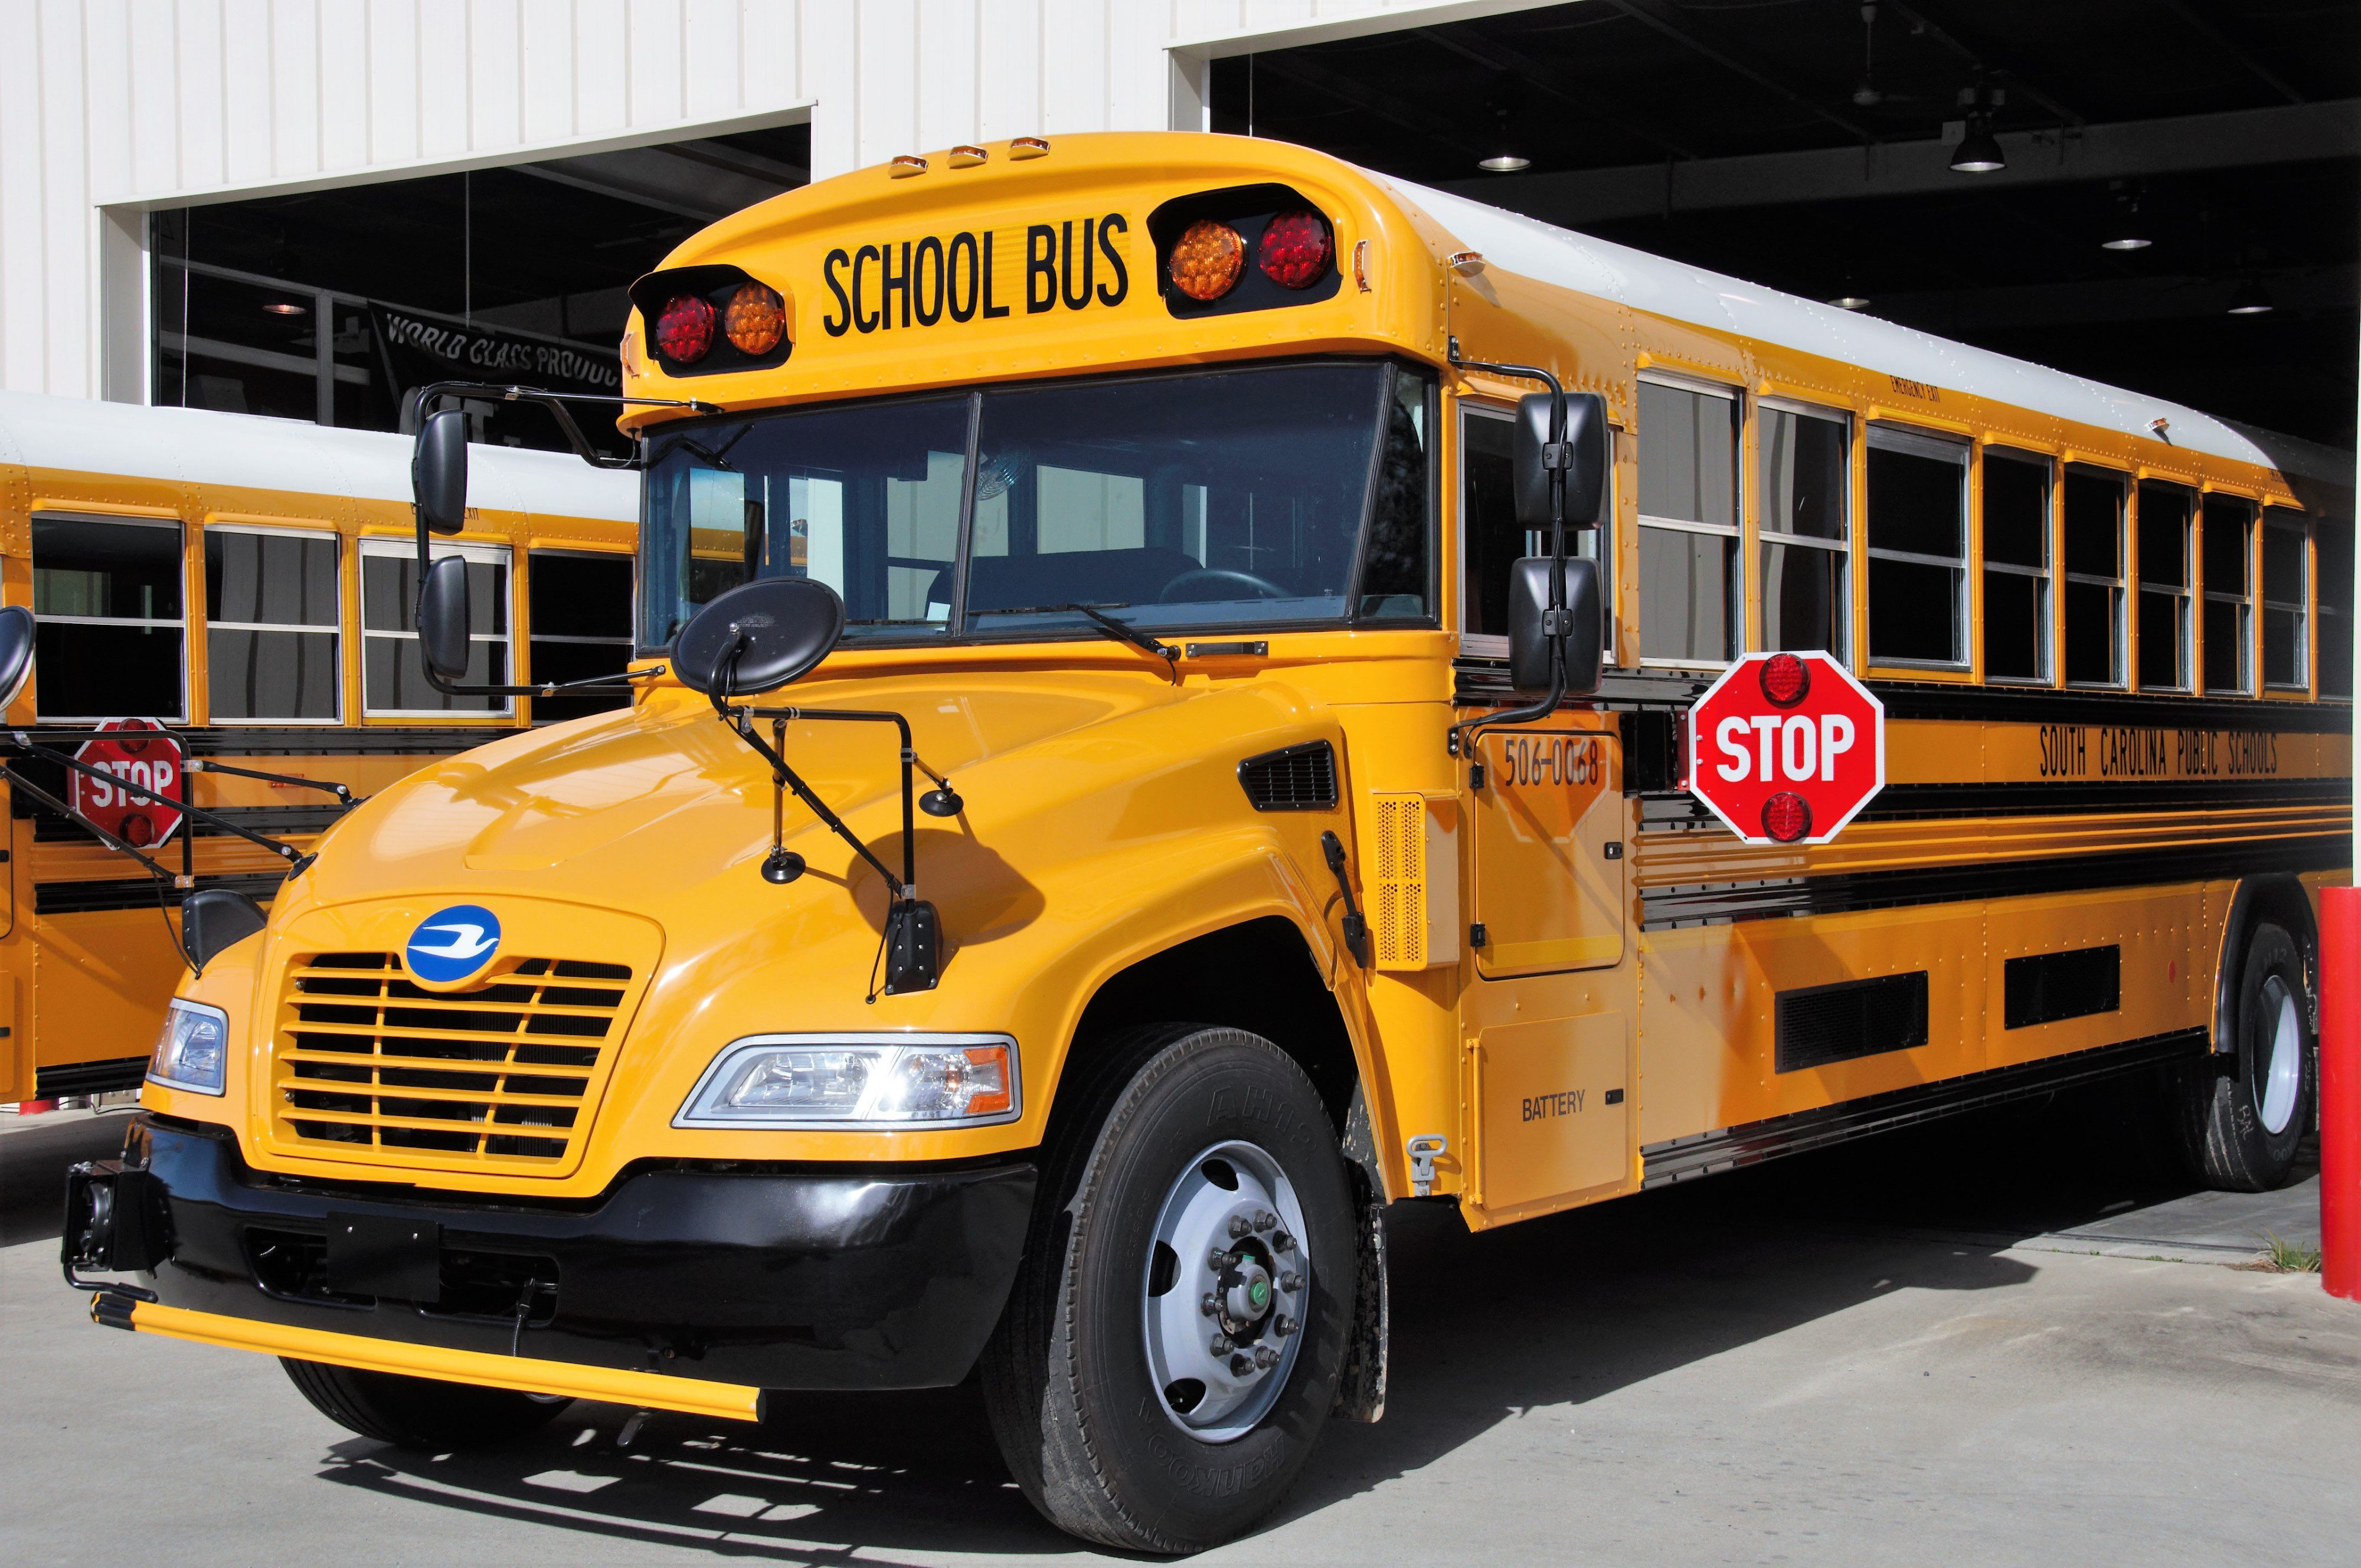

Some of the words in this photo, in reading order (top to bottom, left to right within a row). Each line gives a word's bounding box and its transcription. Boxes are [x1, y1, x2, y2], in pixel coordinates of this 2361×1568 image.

[823, 231, 1010, 338] SCHOOL
[1026, 212, 1129, 315] BUS
[387, 313, 467, 359] WORLD
[469, 338, 531, 370] CLASS
[1890, 375, 1926, 400] EMERGENCY
[1927, 384, 1941, 403] EXIT
[1505, 738, 1598, 787] 506-0068
[1716, 713, 1855, 783] STOP
[2040, 725, 2085, 777] SOUTH
[2100, 728, 2167, 777] CAROLINA
[2177, 729, 2218, 775] PUBLIC
[2228, 731, 2278, 775] SCHOOLS
[91, 760, 174, 808] STOP
[1522, 1089, 1586, 1122] BATTERY
